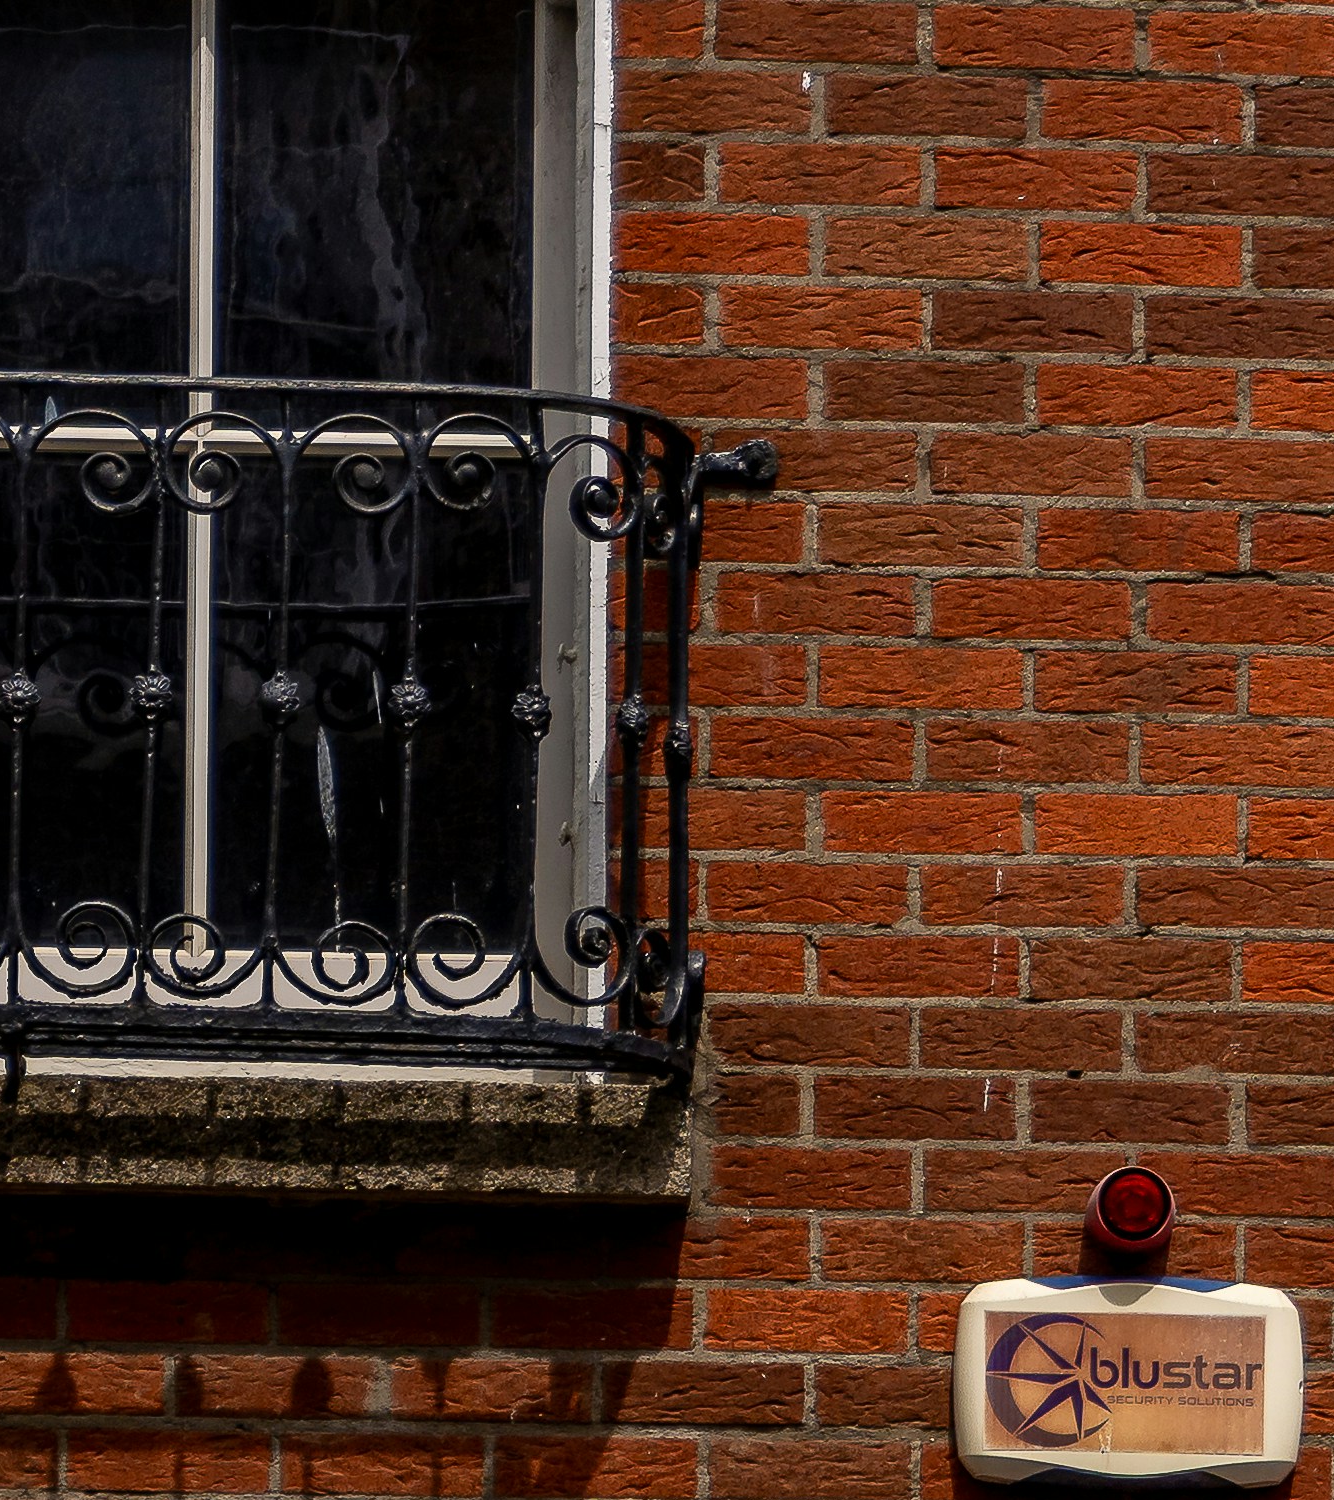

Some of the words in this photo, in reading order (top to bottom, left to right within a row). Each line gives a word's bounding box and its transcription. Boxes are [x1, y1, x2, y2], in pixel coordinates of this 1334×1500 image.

[1090, 1346, 1262, 1390] blustar
[1107, 1395, 1174, 1406] SECURITY
[1178, 1396, 1254, 1407] SOLUTIONS
